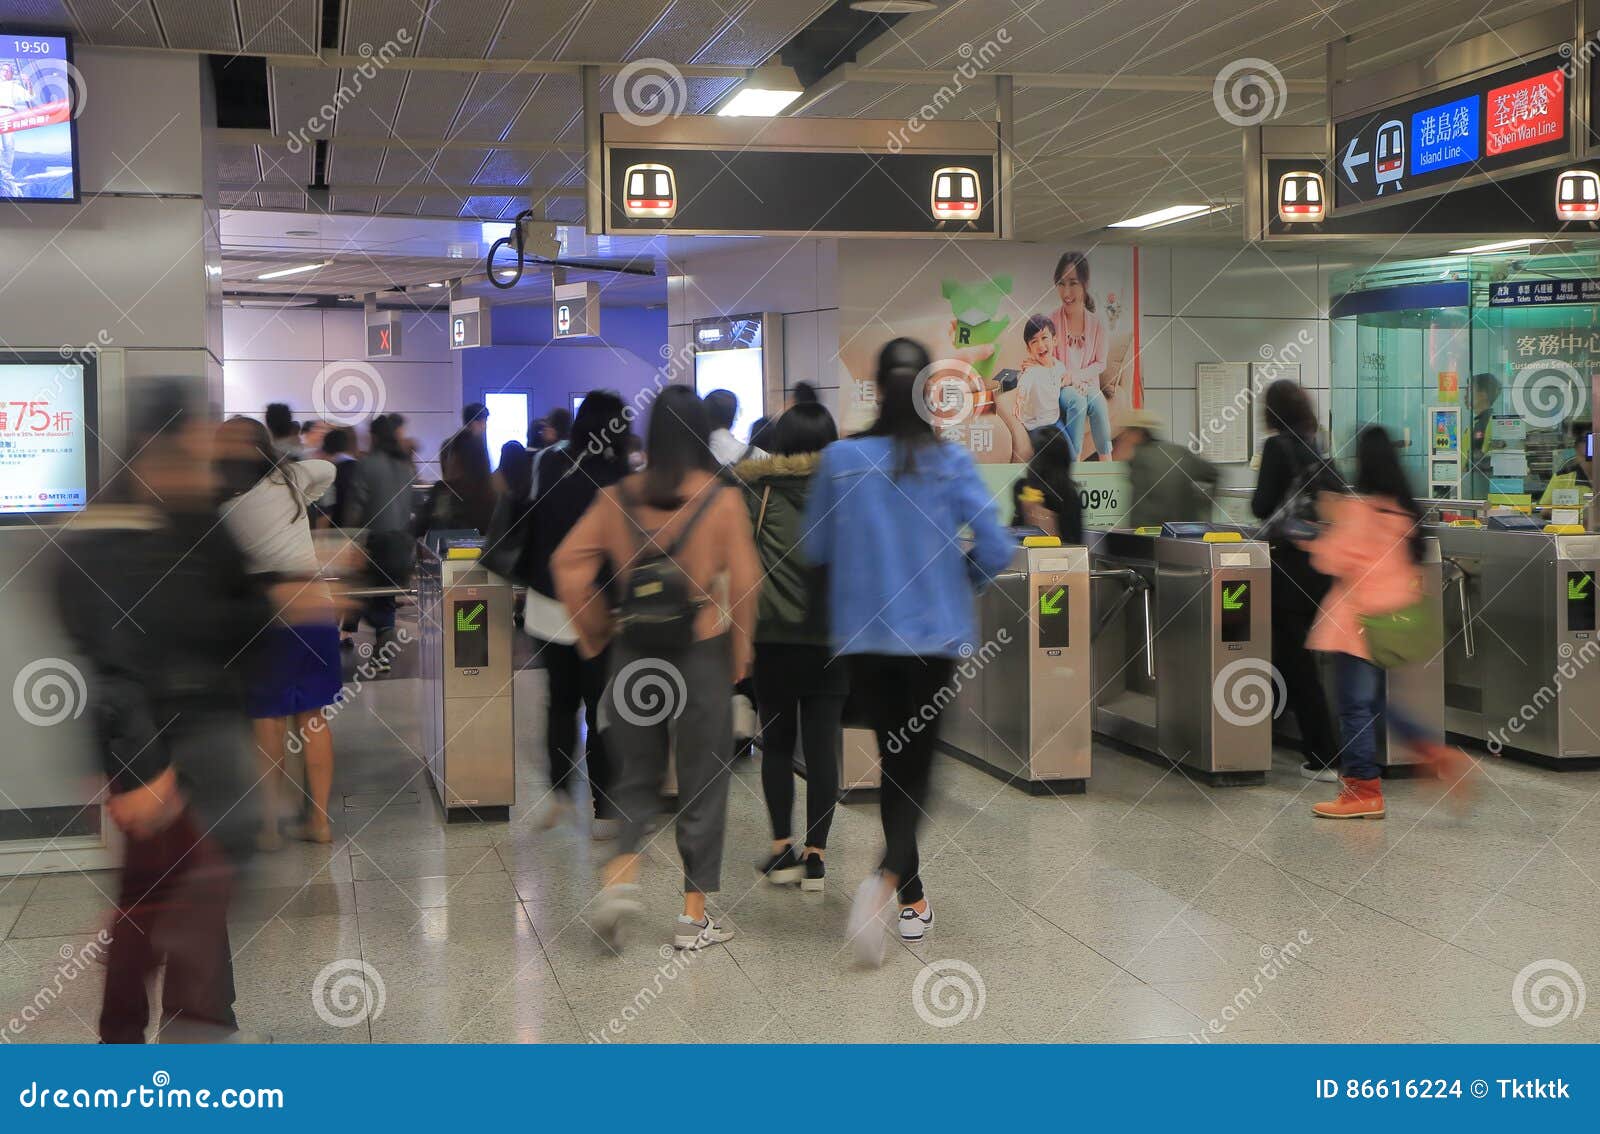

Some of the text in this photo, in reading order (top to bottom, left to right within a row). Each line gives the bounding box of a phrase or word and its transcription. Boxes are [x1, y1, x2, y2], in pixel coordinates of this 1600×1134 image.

[14, 41, 50, 54] 19:50
[1518, 125, 1536, 140] Wan
[1538, 121, 1557, 136] Line
[1420, 145, 1461, 166] Island Line
[959, 327, 970, 344] R
